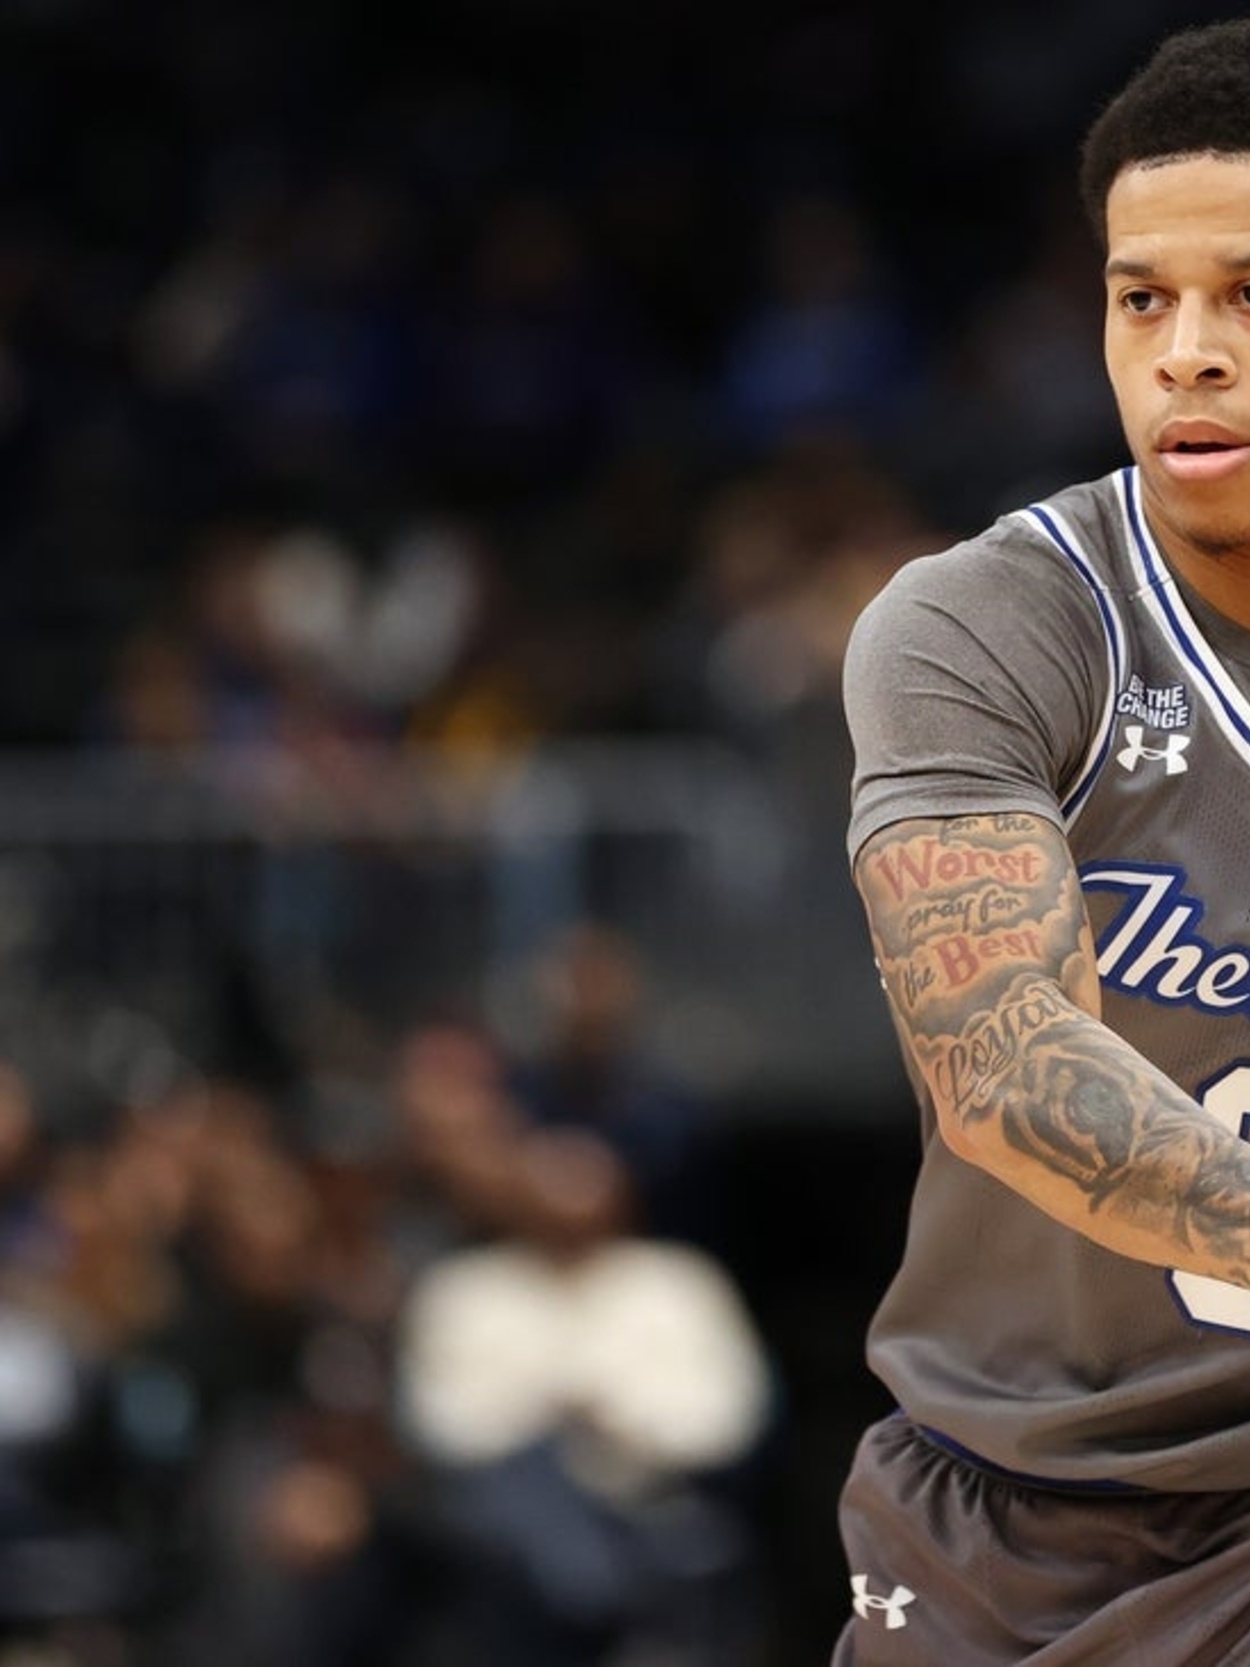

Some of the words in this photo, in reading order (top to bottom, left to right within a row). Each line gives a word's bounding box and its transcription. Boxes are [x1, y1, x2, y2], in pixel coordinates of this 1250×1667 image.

[1116, 692, 1189, 729] CHANGE
[1146, 684, 1184, 709] THE
[940, 816, 980, 846] for
[988, 813, 1036, 833] the
[876, 839, 1041, 901] Worst
[905, 898, 976, 935] pray
[975, 888, 1022, 930] for
[935, 931, 1042, 988] Best
[1081, 870, 1250, 1008] The
